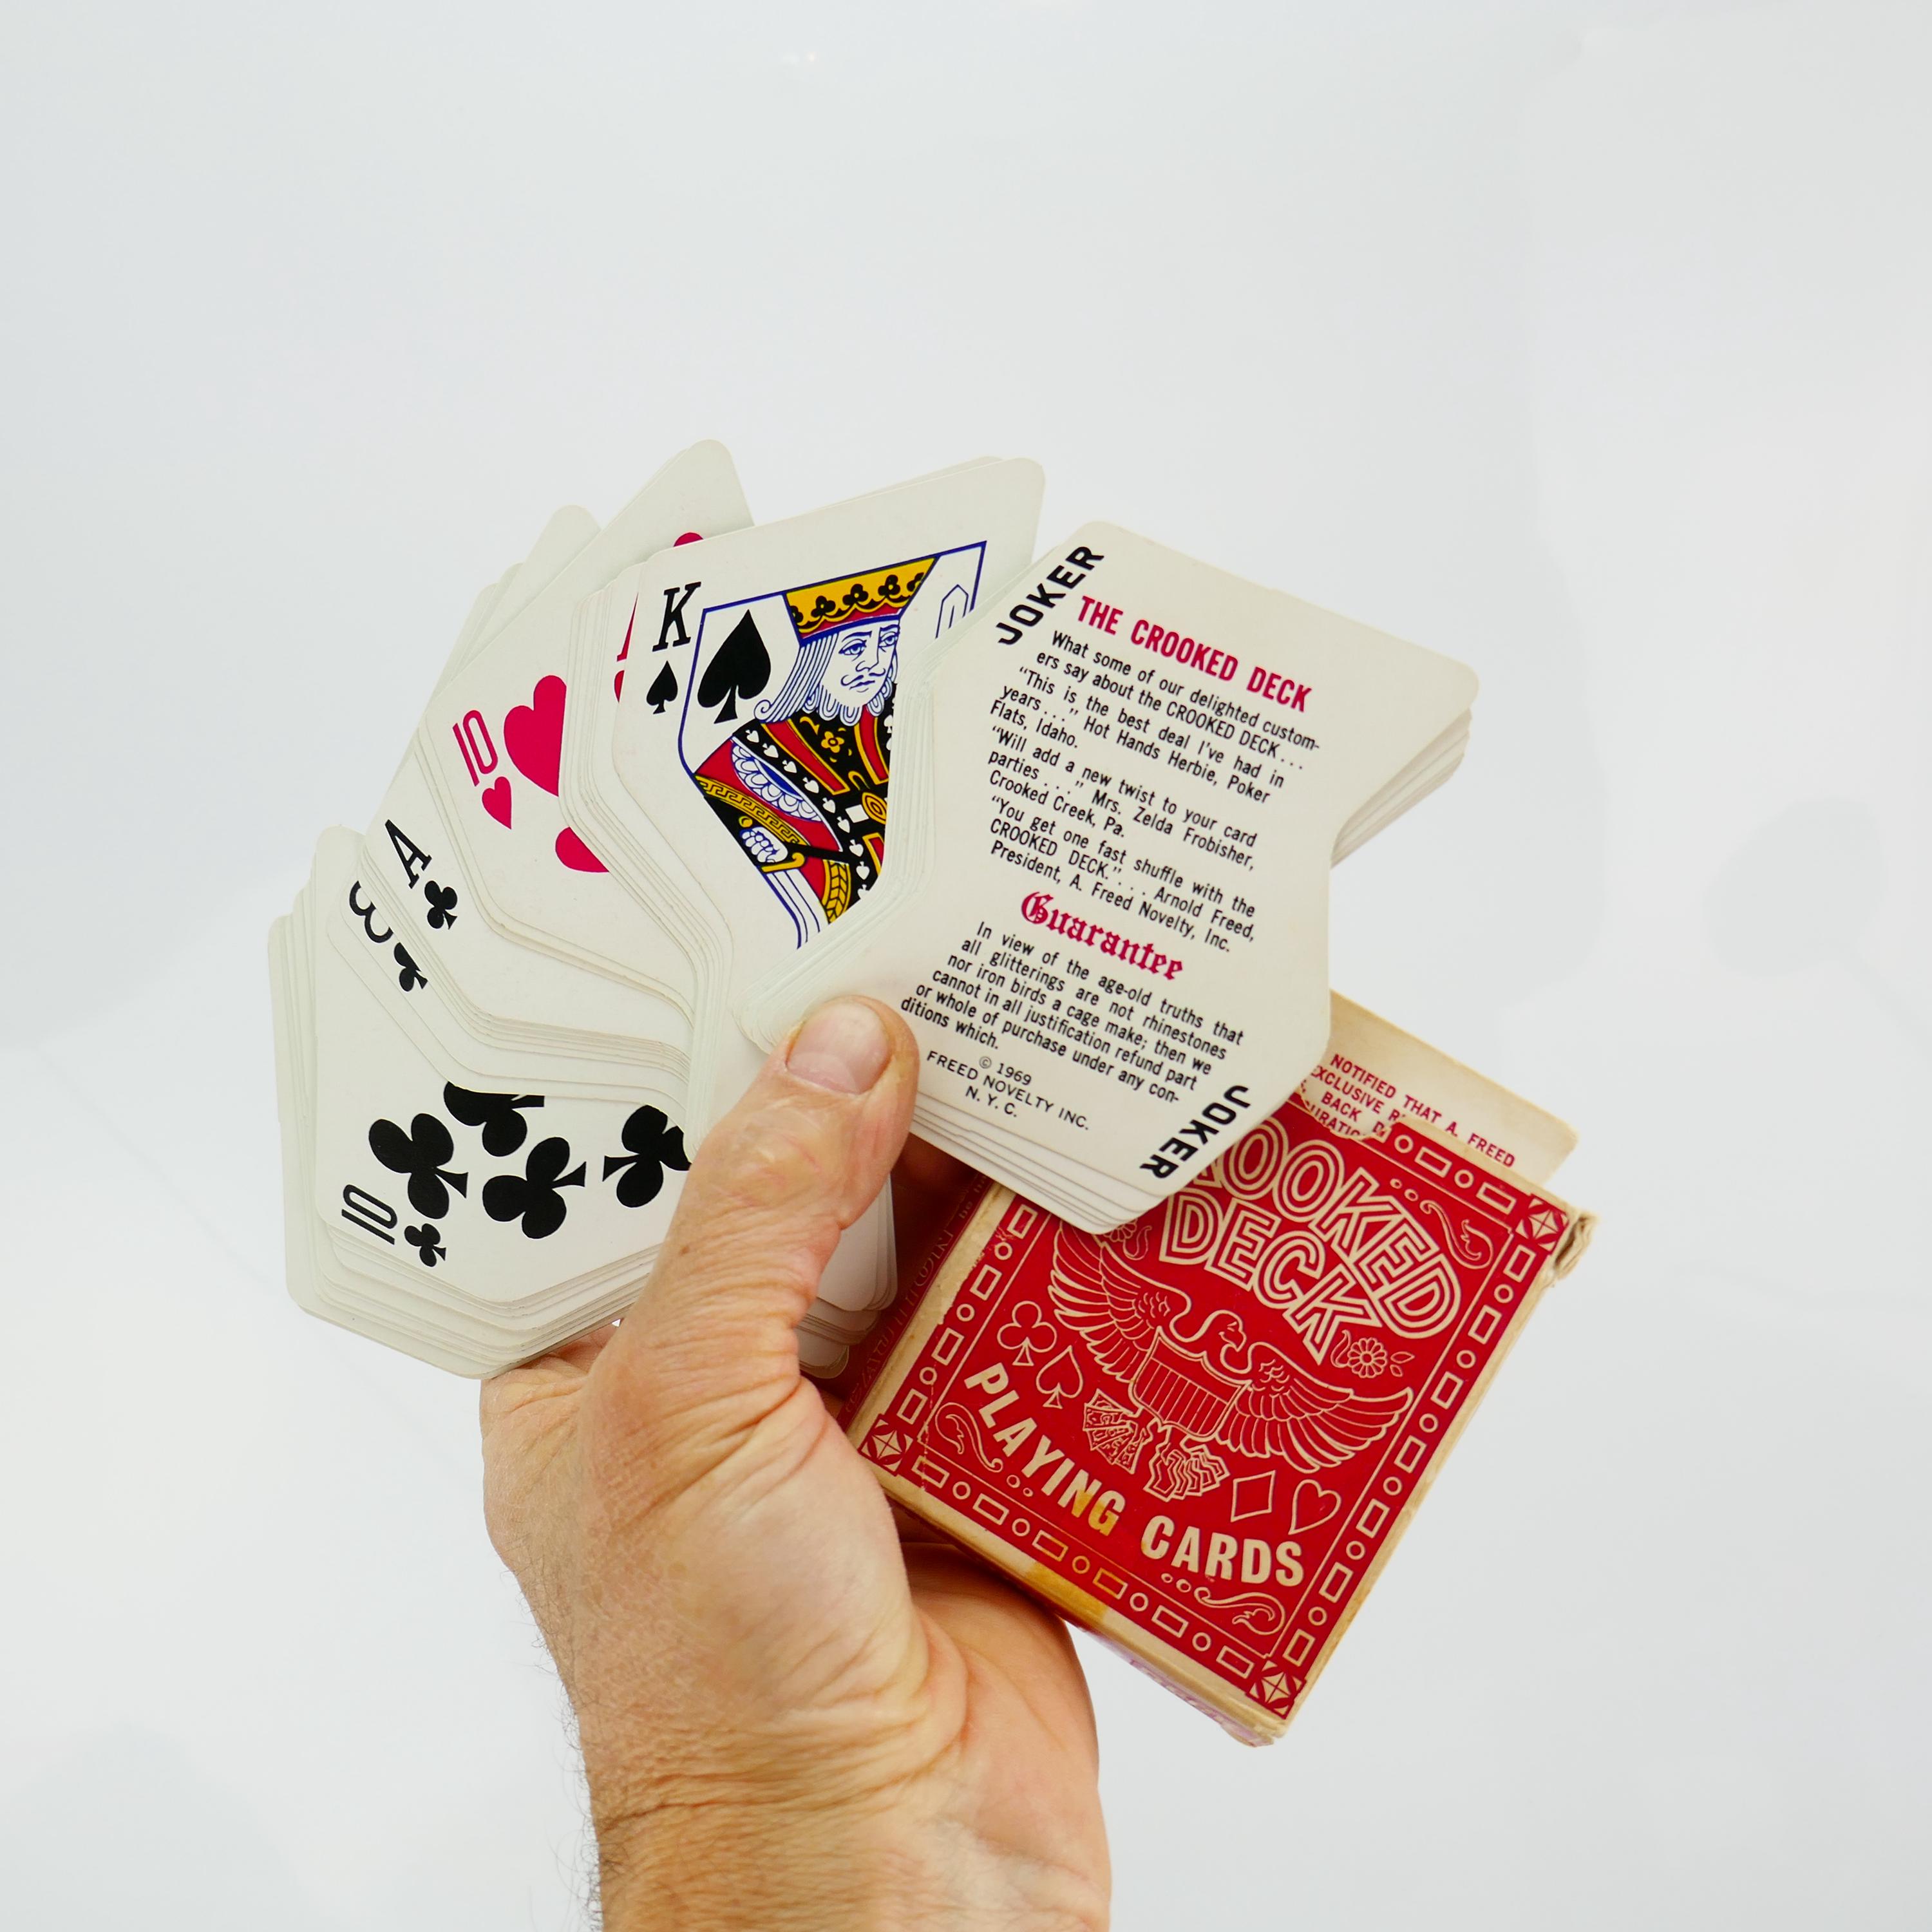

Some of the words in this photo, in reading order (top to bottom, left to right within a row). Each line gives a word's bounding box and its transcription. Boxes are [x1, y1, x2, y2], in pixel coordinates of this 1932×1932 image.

[652, 582, 702, 652] K
[995, 545, 1105, 645] JOKER
[1036, 652, 1060, 670] ers
[1063, 663, 1090, 683] say
[1092, 674, 1134, 701] about
[1137, 689, 1162, 711] the
[1166, 701, 1235, 740] CROOKED
[1052, 630, 1089, 659] What
[1092, 652, 1132, 676] some
[1137, 669, 1156, 684] of
[1159, 679, 1185, 696] our
[1189, 689, 1260, 728] delighted
[1262, 721, 1320, 751] custom-
[1077, 595, 1124, 636] THE
[1130, 619, 1239, 681] CROOKED
[1245, 666, 1312, 713] DECK
[453, 710, 498, 787] 10
[990, 699, 1027, 730] Flats,
[1036, 717, 1078, 748] Idaho.
[1063, 685, 1077, 703] is
[1086, 696, 1109, 716] the
[1117, 707, 1151, 734] best
[1158, 726, 1191, 750] deal
[1197, 740, 1225, 764] I've
[1233, 755, 1262, 779] had
[1269, 769, 1284, 788] in
[1083, 715, 1110, 739] Hot
[1116, 729, 1160, 760] Hands
[1167, 750, 1217, 786] Herbie,
[1226, 774, 1271, 804] Poker
[989, 769, 1050, 805] Crooked
[1052, 795, 1096, 828] Creek,
[1103, 815, 1124, 838] Pa.
[1032, 747, 1061, 767] add
[1065, 761, 1075, 773] a
[1081, 767, 1112, 787] new
[1118, 779, 1155, 806] twist
[1162, 797, 1177, 815] to
[1182, 809, 1218, 830] your
[1224, 826, 1258, 848] card
[1091, 789, 1121, 815] Mrs.
[1132, 806, 1173, 835] Zelda
[1182, 827, 1253, 871] Frobisher,
[385, 819, 433, 889] A
[990, 818, 1058, 857] CROOKED
[1153, 886, 1204, 918] Arnold
[1210, 909, 1255, 942] Freed,
[990, 839, 1061, 884] President,
[1069, 873, 1082, 891] A.
[1091, 881, 1134, 911] Freed
[1138, 900, 1195, 940] Novelty,
[1204, 927, 1229, 952] Inc.
[1029, 817, 1056, 836] get
[1063, 830, 1089, 849] one
[1097, 840, 1127, 865] fast
[1133, 858, 1184, 888] shuffle
[1192, 882, 1224, 904] with
[1231, 896, 1255, 918] the
[349, 880, 394, 943] 3
[1021, 891, 1183, 981] Guarantee
[900, 996, 950, 1028] ditions
[956, 1020, 998, 1050] which.
[933, 970, 981, 999] cannot
[984, 987, 999, 1007] in
[1002, 999, 1023, 1016] all
[1023, 1005, 1111, 1054] justification
[1114, 1047, 1164, 1075] refund
[1164, 1068, 1197, 1091] part
[947, 954, 973, 972] nor
[976, 963, 1006, 988] iron
[1010, 978, 1047, 1005] birds
[1052, 999, 1062, 1012] a
[1066, 1005, 1100, 1028] cage
[1104, 1021, 1148, 1050] make;
[1154, 1039, 1186, 1065] then
[1191, 1057, 1212, 1075] we
[961, 939, 982, 956] all
[989, 952, 1065, 992] glitterings
[1075, 988, 1100, 1006] are
[1109, 1001, 1135, 1021] not
[1142, 1014, 1227, 1060] rhinestones
[976, 921, 992, 940] In
[1002, 934, 1035, 956] view
[1042, 952, 1060, 966] of
[1066, 958, 1090, 980] the
[1097, 976, 1153, 1007] age-old
[1159, 998, 1204, 1028] truths
[1213, 1021, 1244, 1046] that
[916, 984, 933, 998] or
[936, 990, 977, 1018] whole
[982, 1012, 1000, 1027] of
[1001, 1020, 1067, 1057] purchase
[1072, 1048, 1116, 1077] under
[1117, 1070, 1146, 1092] any
[1148, 1082, 1180, 1105] con-
[925, 1050, 979, 1081] FREED
[983, 1074, 1055, 1113] NOVELTY
[1057, 1106, 1090, 1132] INC.
[996, 1063, 1032, 1086] 1969
[1139, 1084, 1251, 1179] JOKER
[1321, 1091, 1362, 1122] BACK
[1330, 1054, 1396, 1099] NOTIFIED
[1404, 1095, 1443, 1124] THAT
[1467, 1133, 1516, 1169] FREED
[342, 1184, 397, 1245] 10
[1191, 1116, 1461, 1340] OOKED
[1158, 1188, 1383, 1366] DECK
[965, 1362, 1126, 1537] PLAYING
[1140, 1515, 1305, 1587] CARDS
